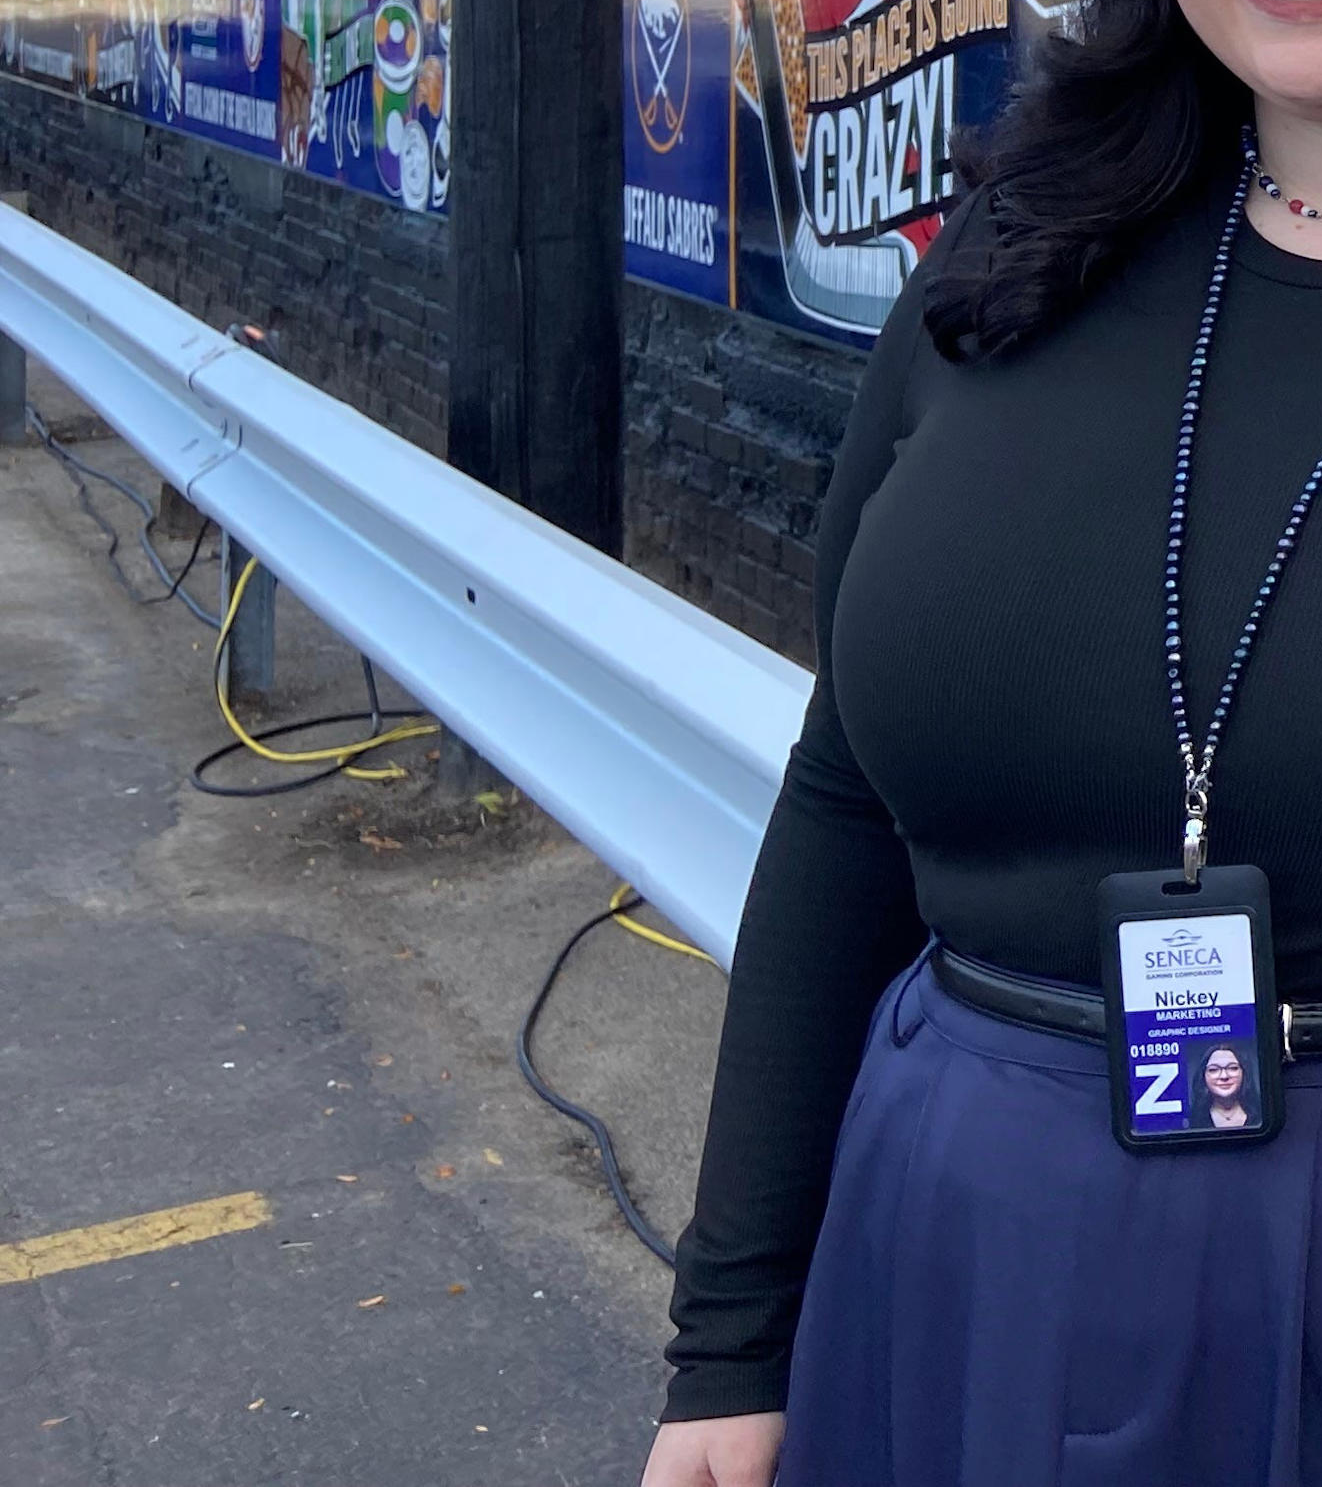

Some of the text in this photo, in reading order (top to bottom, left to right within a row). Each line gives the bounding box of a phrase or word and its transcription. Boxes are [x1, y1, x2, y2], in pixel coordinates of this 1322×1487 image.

[807, 35, 848, 103] THIS
[813, 53, 955, 236] CRAZY!
[624, 184, 716, 266] UFFALO SABRES
[1145, 947, 1222, 969] SENECA
[1155, 990, 1219, 1008] Nickey
[1156, 1008, 1222, 1021] MARKETING
[1130, 1042, 1180, 1058] 018890
[1135, 1062, 1183, 1116] Z
